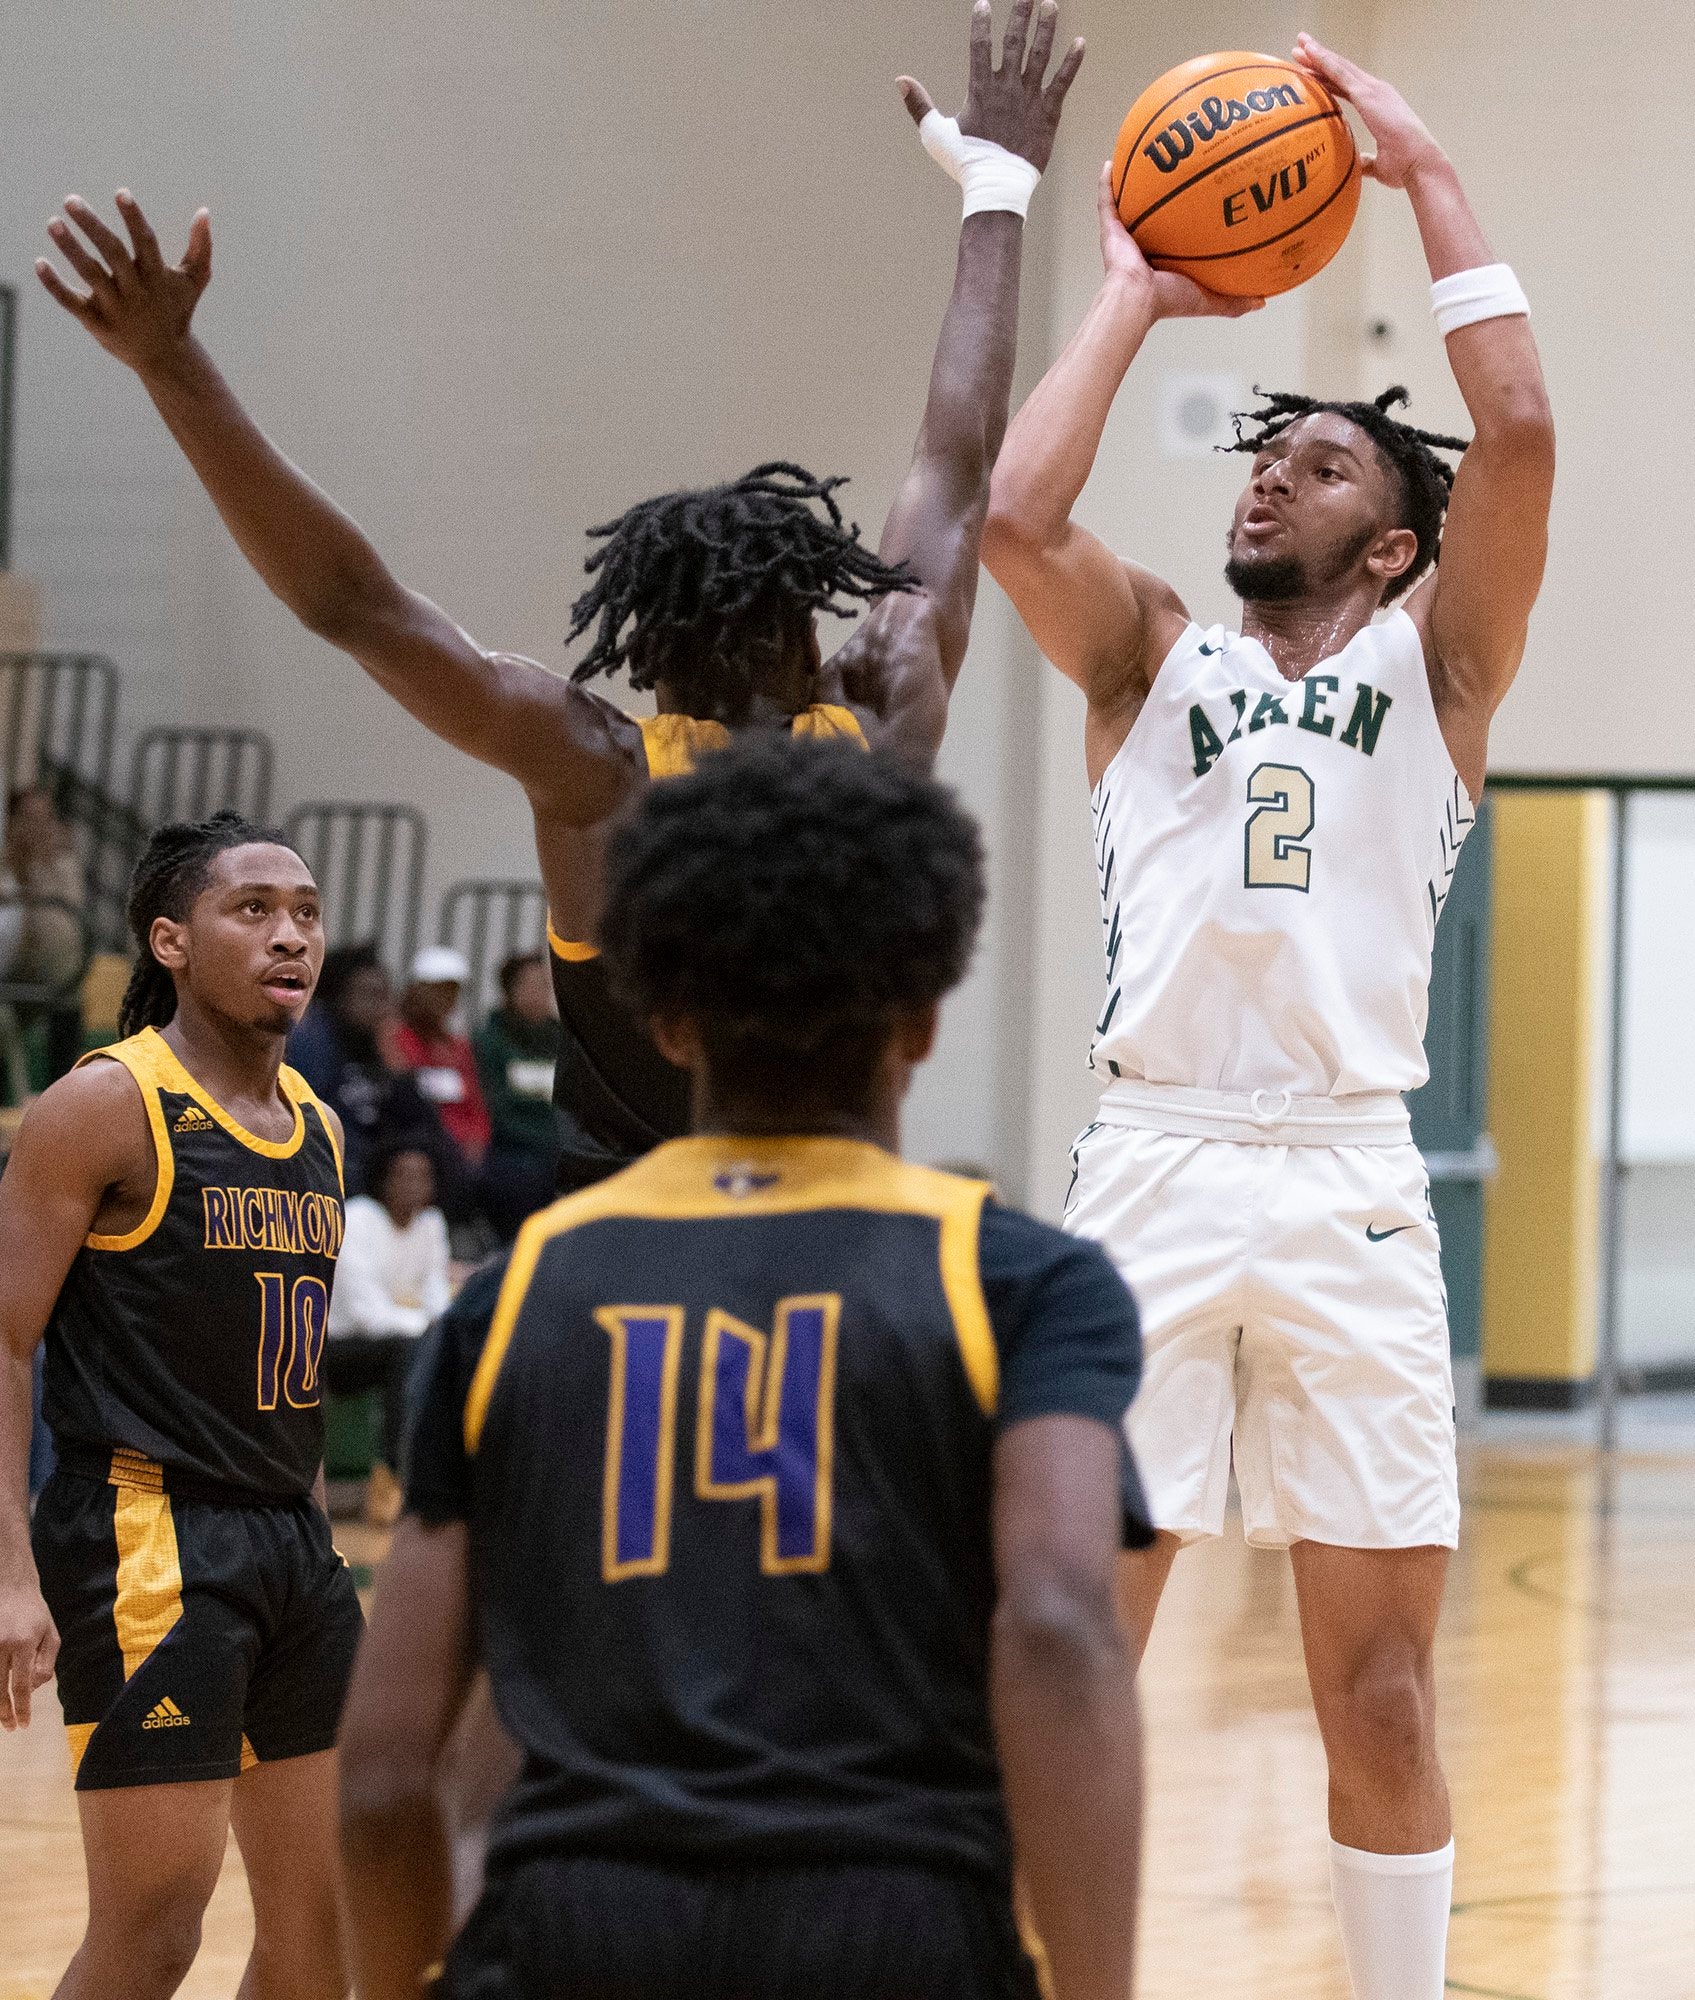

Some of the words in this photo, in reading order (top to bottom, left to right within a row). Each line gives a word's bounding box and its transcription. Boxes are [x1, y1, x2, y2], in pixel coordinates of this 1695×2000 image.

[1143, 83, 1305, 174] Wilson
[1222, 158, 1309, 228] EVO
[1305, 142, 1327, 164] NXT
[1187, 675, 1393, 778] AIKEN
[1244, 762, 1315, 894] 2
[173, 1119, 214, 1133] adidas
[201, 1186, 345, 1260] RICHMOND
[253, 1271, 328, 1411] 10
[592, 1292, 843, 1584] 14
[142, 1716, 191, 1730] adidas
